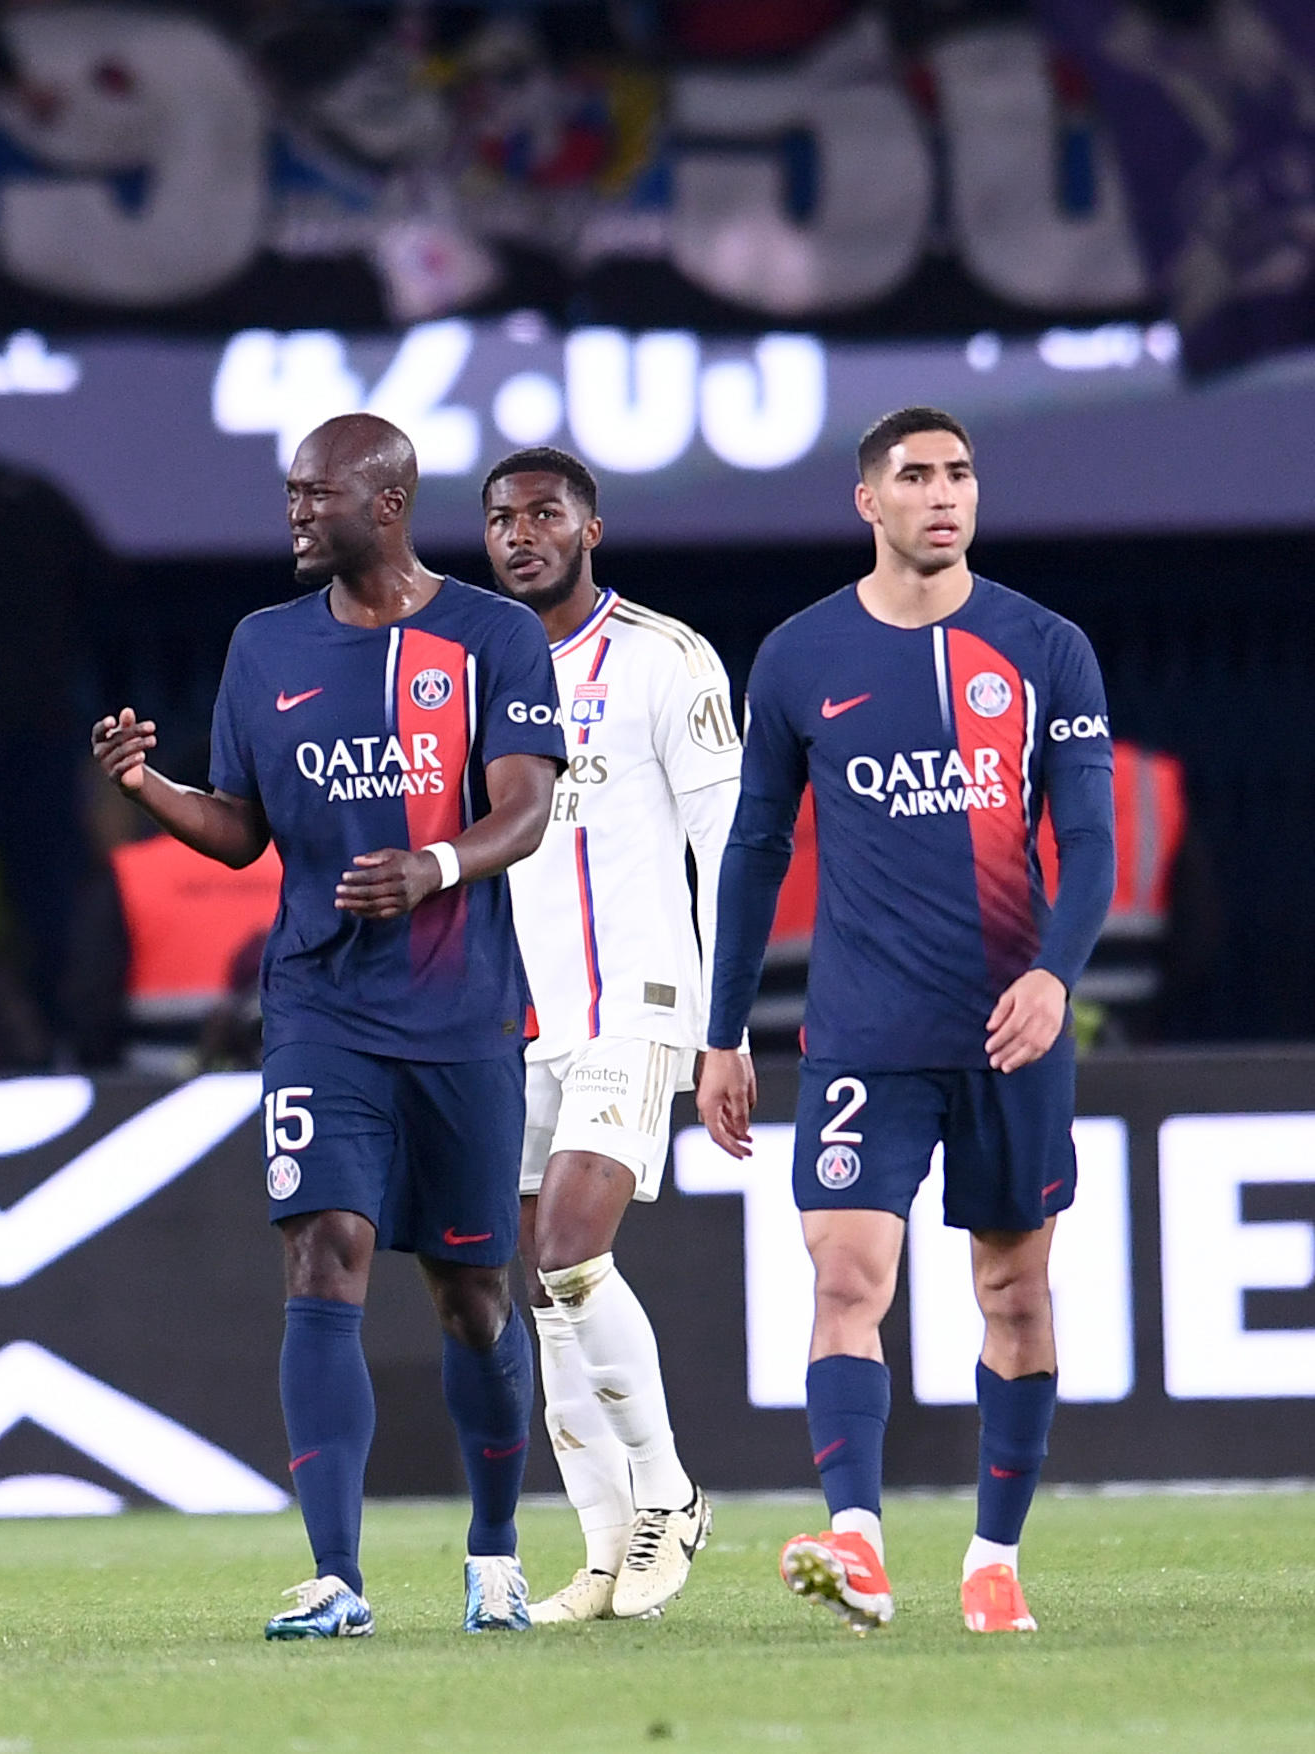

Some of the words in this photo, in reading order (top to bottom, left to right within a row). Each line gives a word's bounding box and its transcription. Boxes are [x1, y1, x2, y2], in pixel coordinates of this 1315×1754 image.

[573, 700, 602, 720] OL
[1049, 714, 1109, 742] GOA
[296, 733, 442, 787] QATAR
[846, 747, 1003, 802] QATAR
[328, 771, 445, 802] AIRWAYS
[889, 783, 1007, 818] AIRWAYS
[575, 1068, 629, 1085] match
[264, 1086, 314, 1158] 15
[820, 1077, 867, 1144] 2
[673, 1112, 1315, 1408] THE
